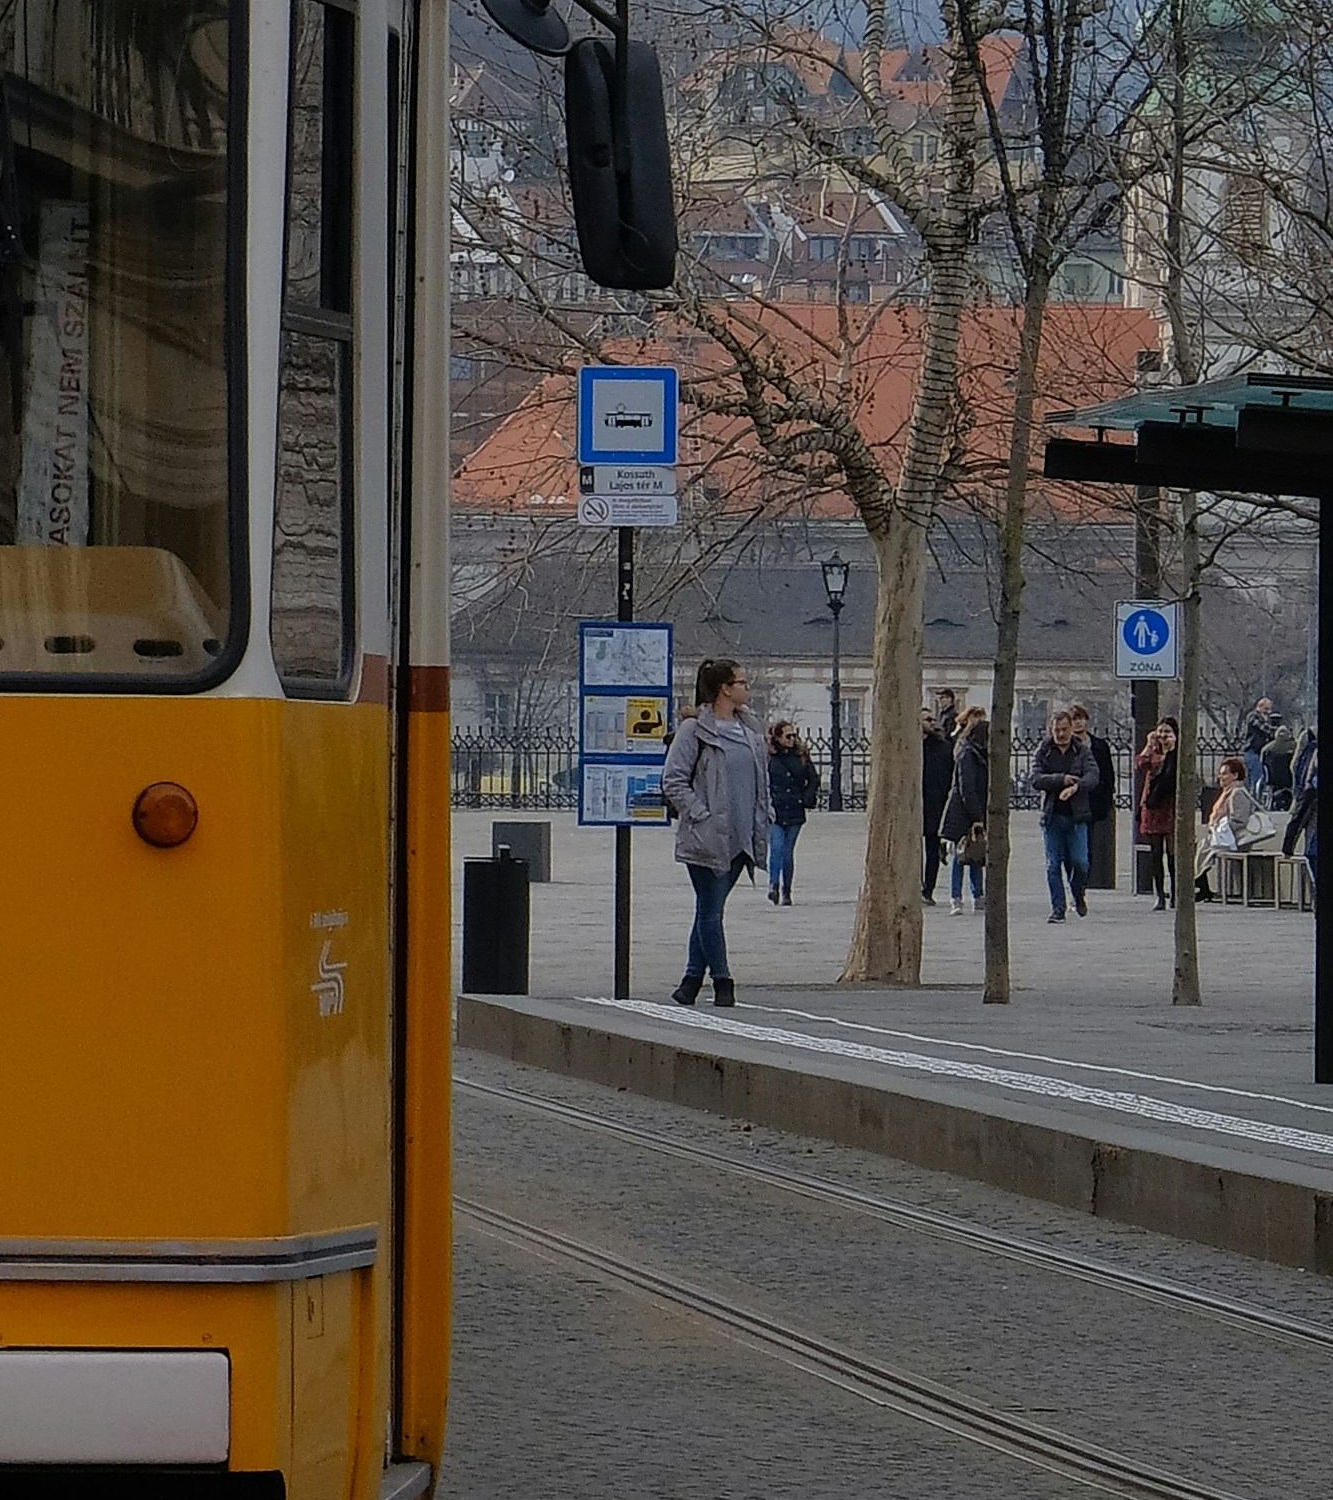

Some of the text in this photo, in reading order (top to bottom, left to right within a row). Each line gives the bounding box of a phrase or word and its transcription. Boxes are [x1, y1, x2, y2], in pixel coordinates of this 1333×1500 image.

[57, 349, 84, 418] NEM
[636, 480, 652, 491] tér
[653, 481, 664, 491] M
[1129, 660, 1163, 673] ZÓNA
